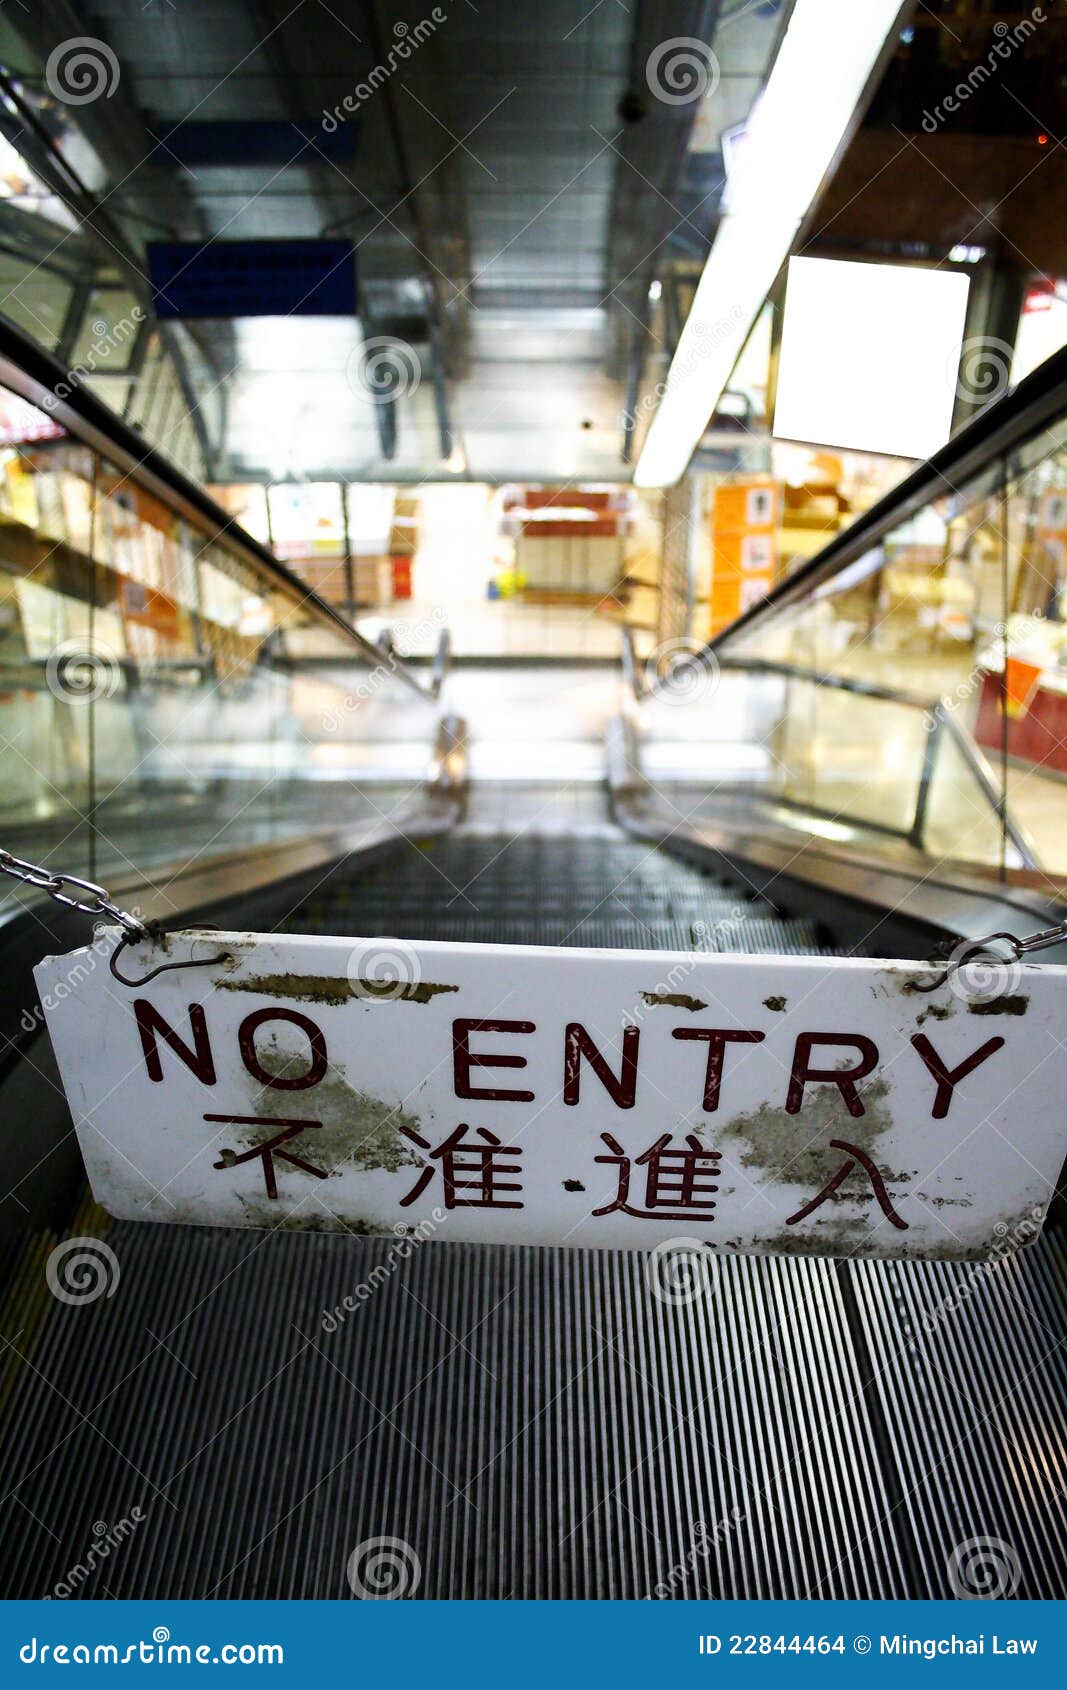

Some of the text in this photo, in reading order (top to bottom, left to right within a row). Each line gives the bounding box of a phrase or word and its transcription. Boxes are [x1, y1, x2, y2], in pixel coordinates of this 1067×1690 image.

[134, 998, 1005, 1120] NO ENTRY
[203, 1112, 909, 1230] 不准進入
